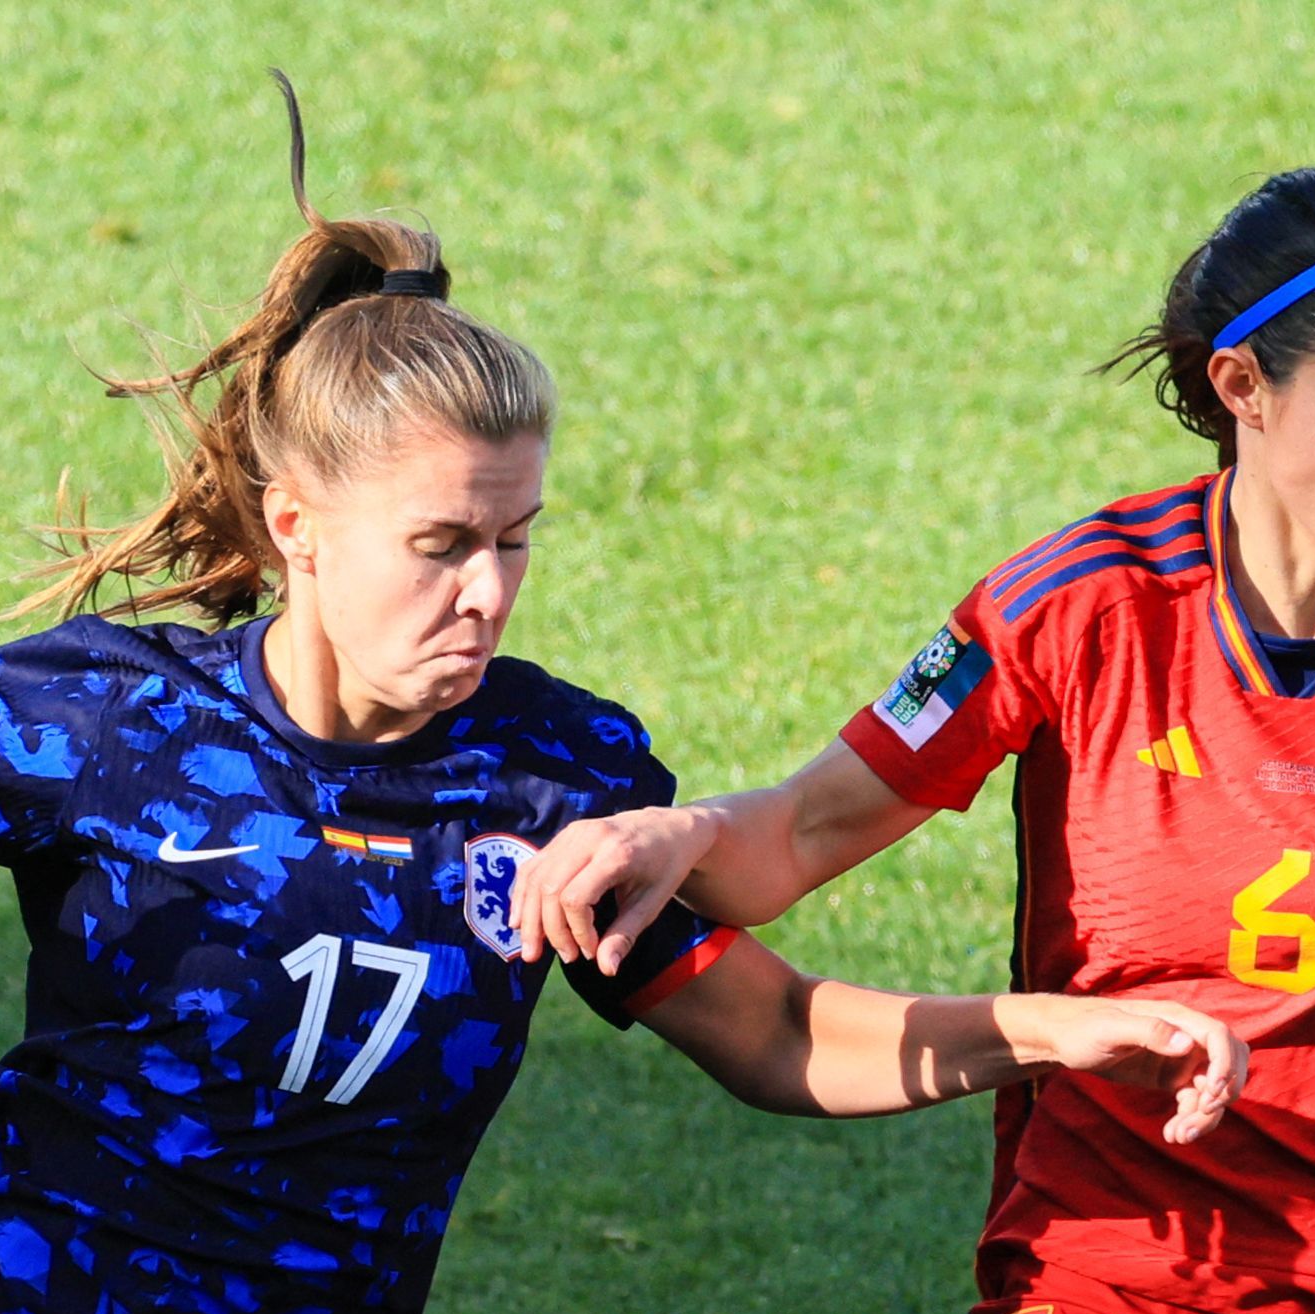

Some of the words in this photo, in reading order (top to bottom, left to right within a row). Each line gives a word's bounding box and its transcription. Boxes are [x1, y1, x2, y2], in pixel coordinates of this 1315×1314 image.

[892, 706, 912, 723] 23
[899, 694, 918, 715] 20
[278, 933, 430, 1105] 17
